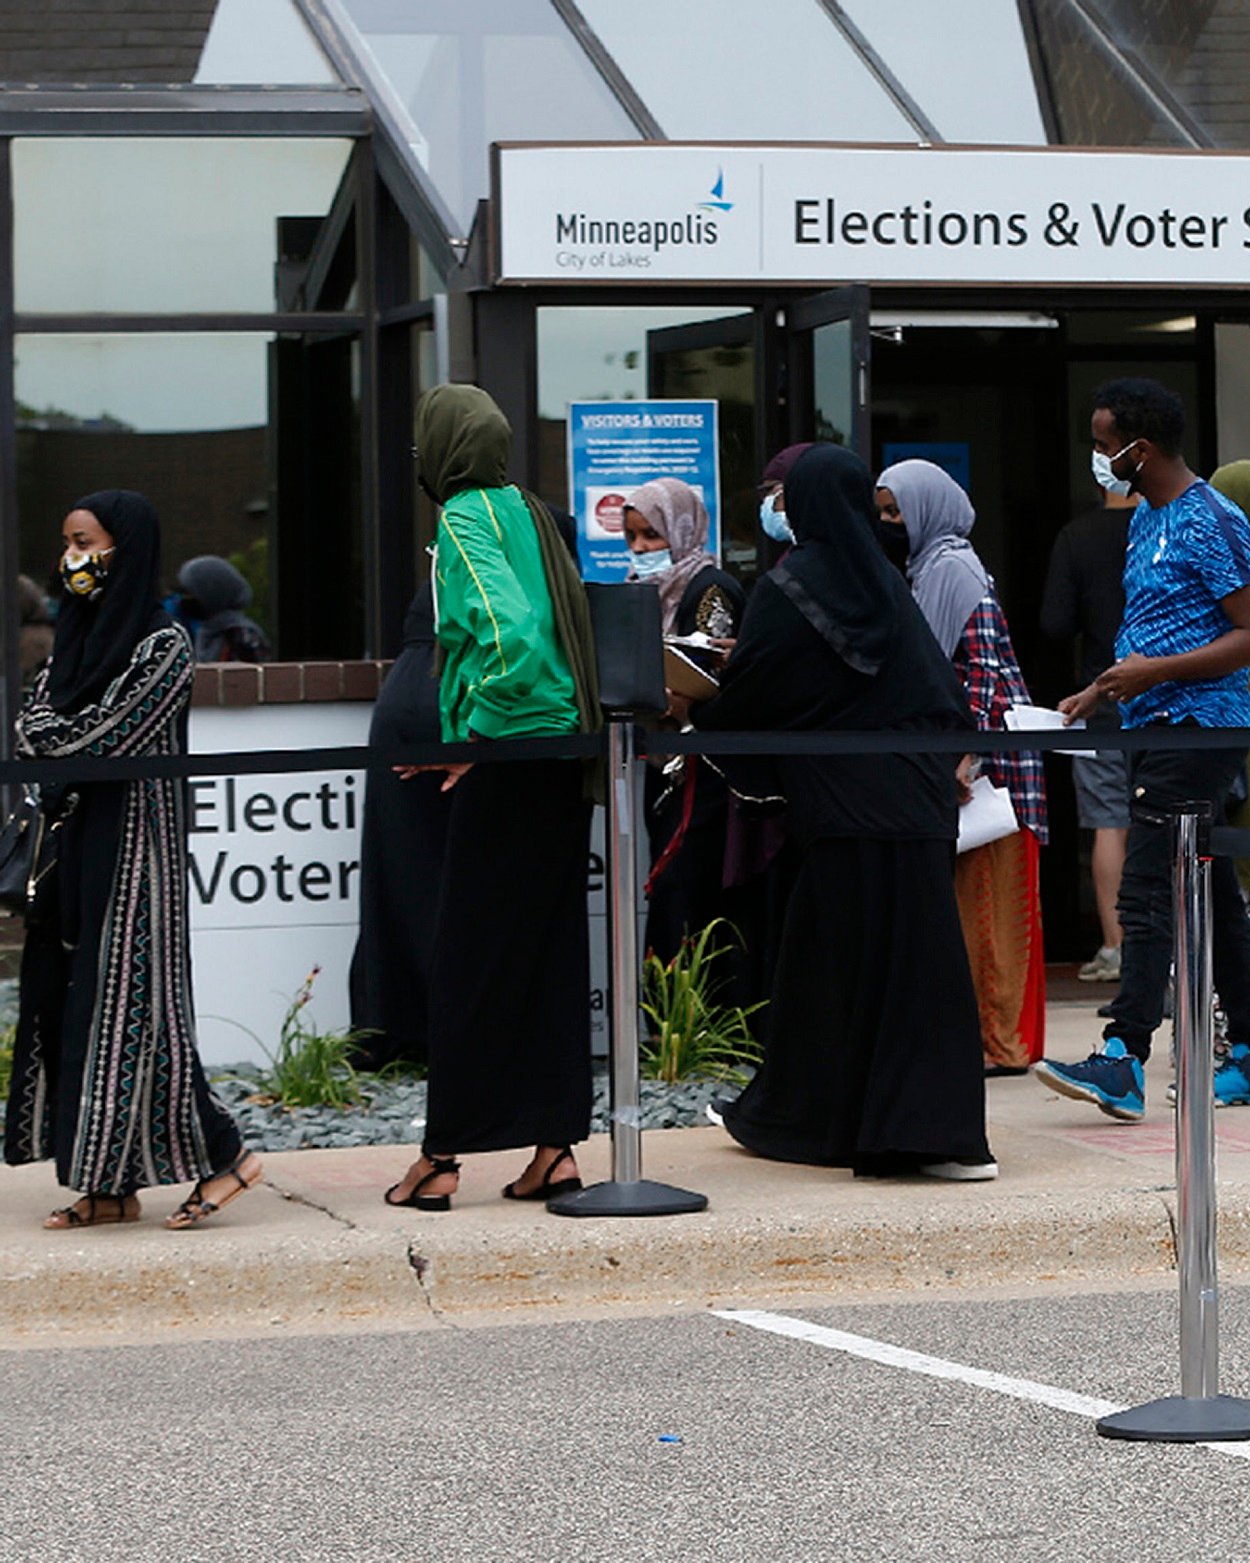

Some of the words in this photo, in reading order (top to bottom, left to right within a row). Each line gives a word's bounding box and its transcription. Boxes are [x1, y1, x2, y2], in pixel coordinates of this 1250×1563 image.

[556, 213, 718, 251] Minneapolis
[795, 197, 1028, 247] Elections
[1043, 202, 1079, 247] &
[1091, 202, 1228, 249] Voter
[556, 250, 585, 269] City
[589, 250, 606, 268] of
[609, 251, 652, 268] Lakes
[581, 414, 640, 428] VISITORS
[654, 414, 704, 428] VOTERS
[187, 851, 360, 905] Voter
